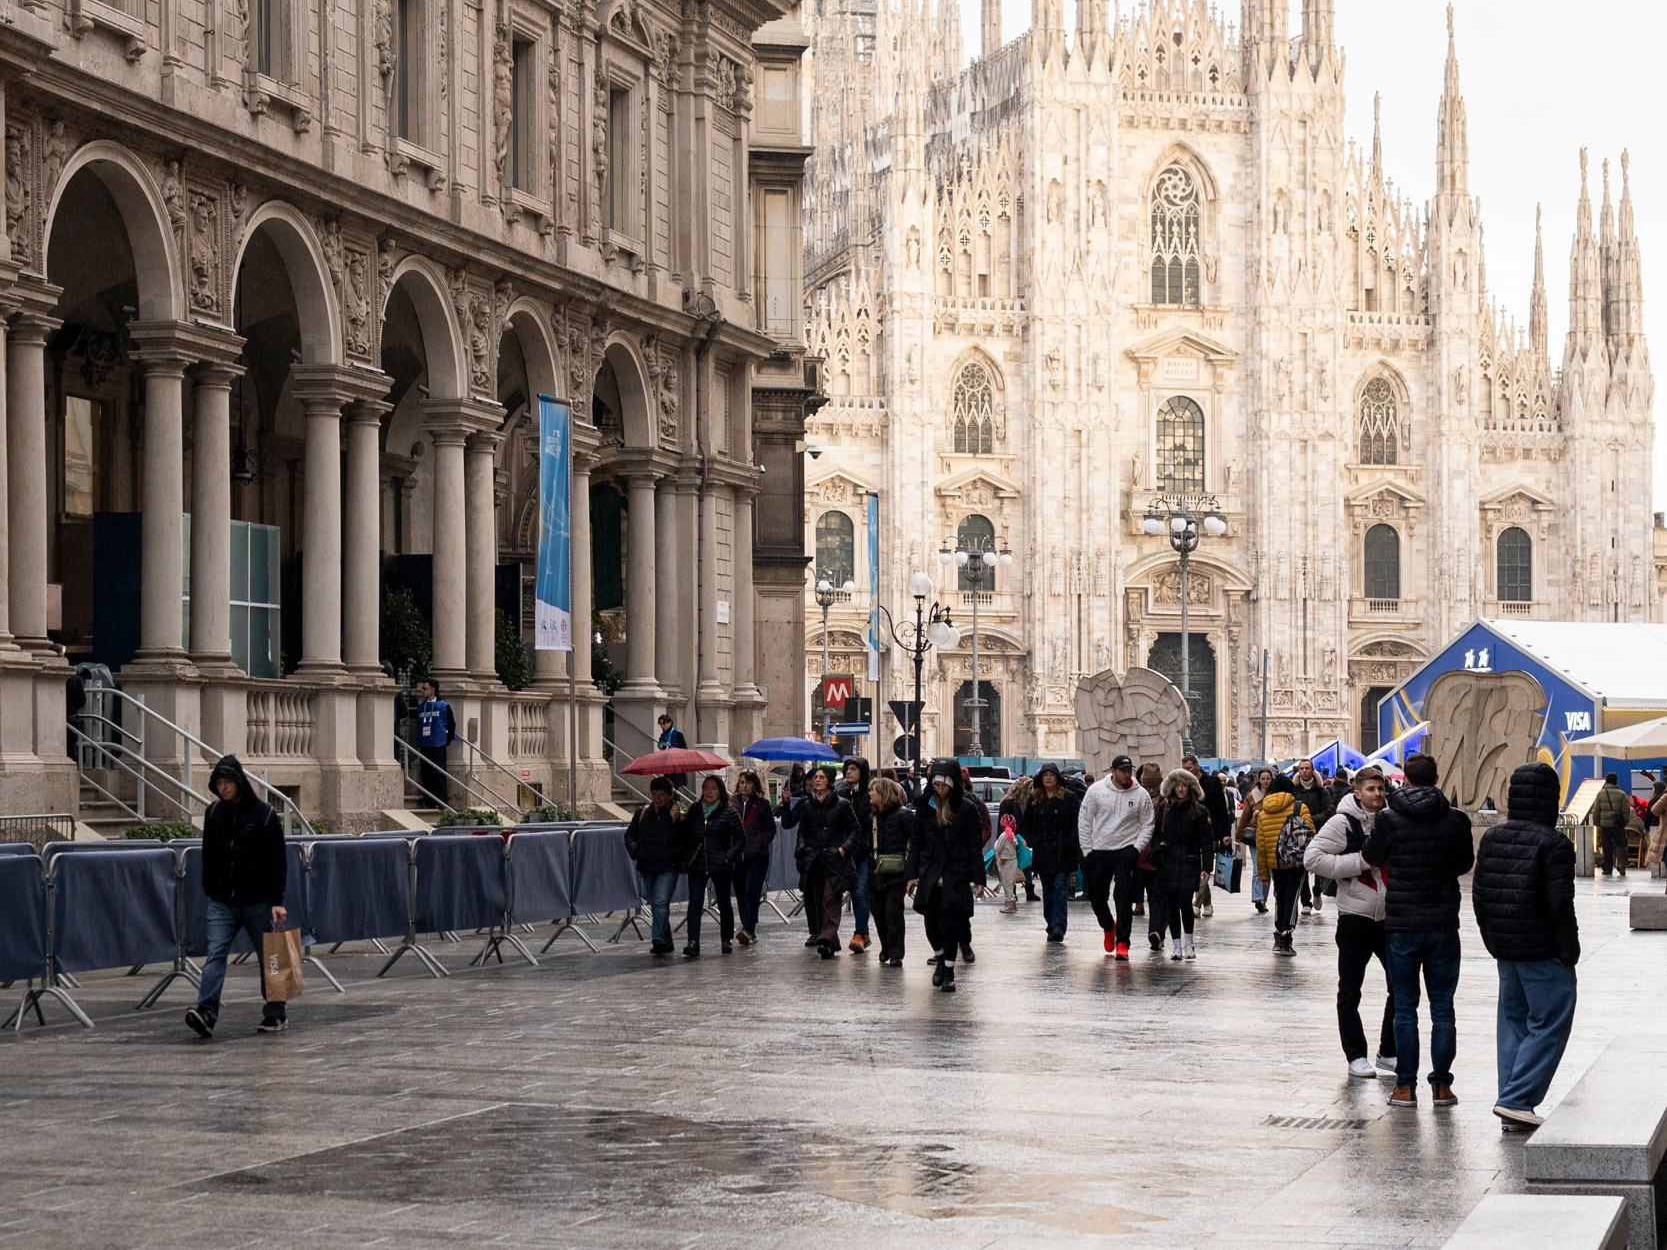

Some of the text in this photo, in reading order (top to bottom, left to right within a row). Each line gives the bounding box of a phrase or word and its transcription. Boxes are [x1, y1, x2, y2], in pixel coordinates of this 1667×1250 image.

[826, 683, 850, 702] M
[1564, 711, 1592, 731] VISA
[269, 953, 279, 976] VISA
